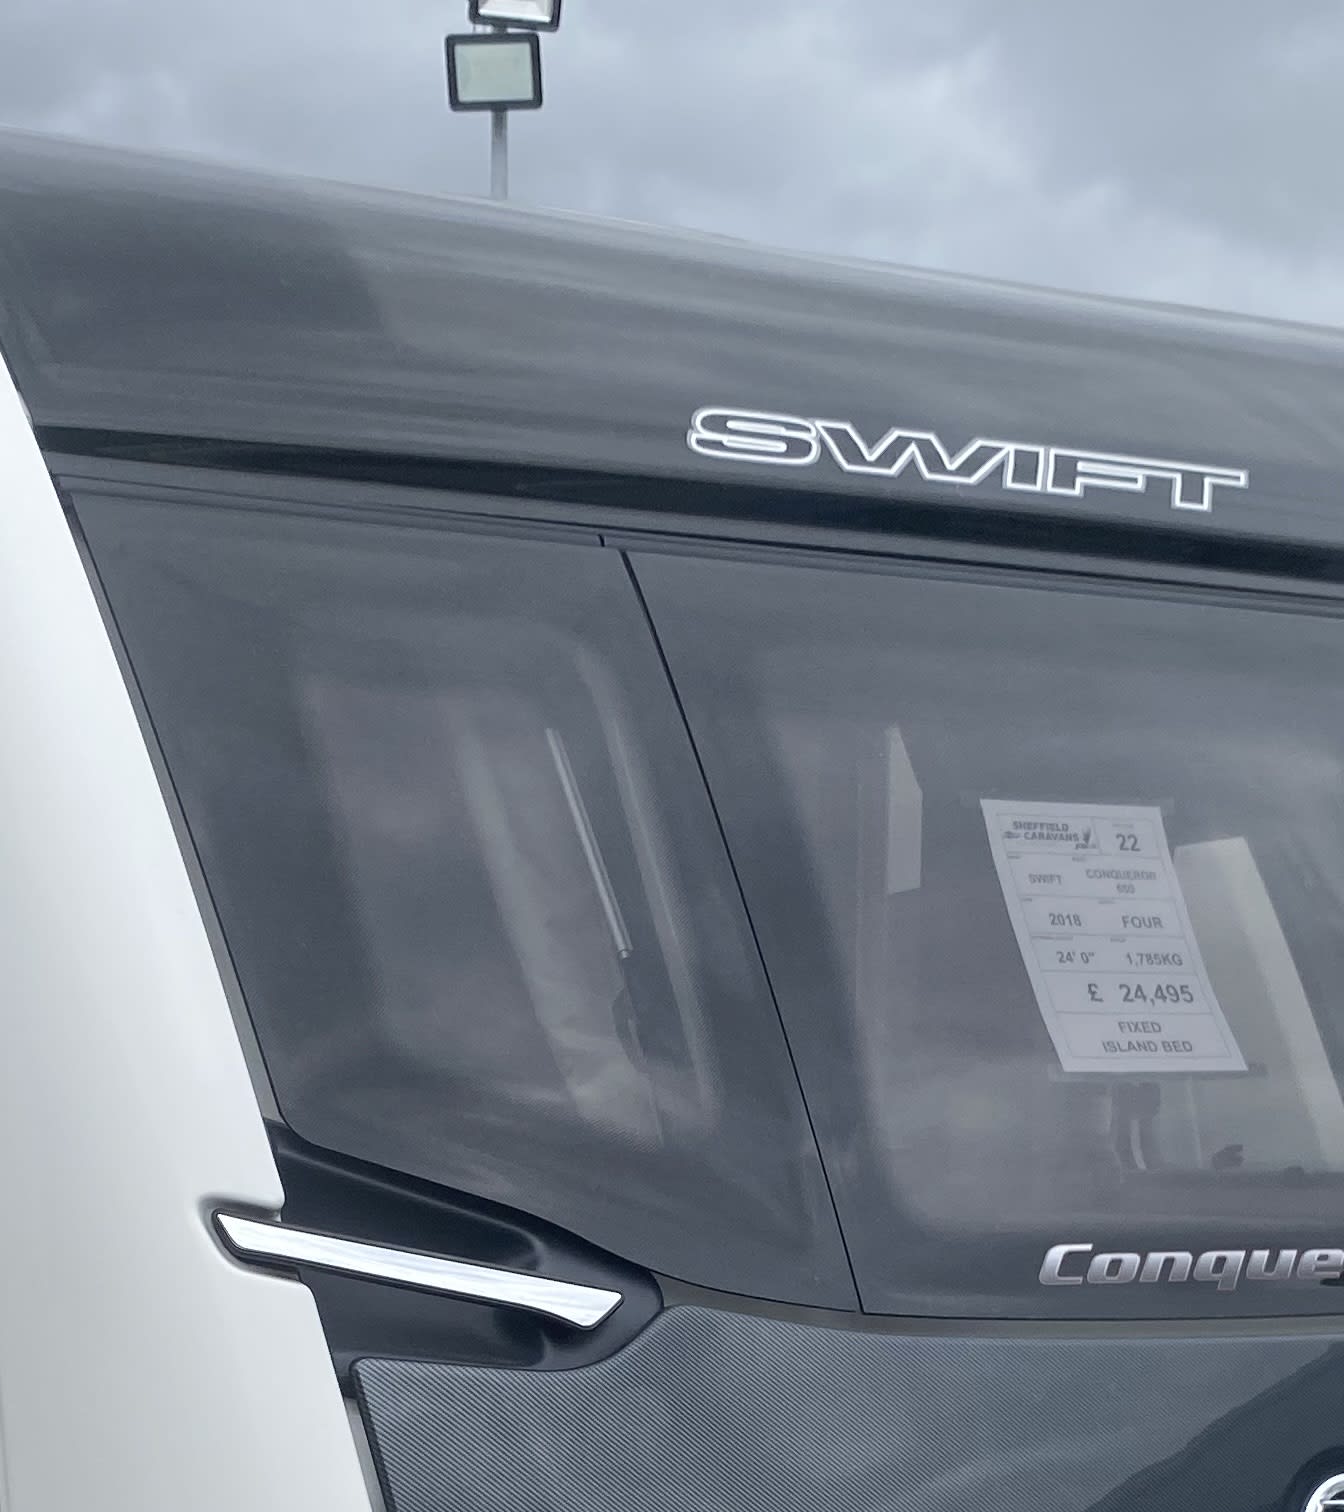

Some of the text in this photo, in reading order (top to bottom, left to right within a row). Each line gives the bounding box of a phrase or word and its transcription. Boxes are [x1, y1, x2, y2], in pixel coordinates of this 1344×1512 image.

[688, 406, 1249, 511] SWIFT
[1023, 831, 1079, 842] CARAVANS
[1115, 833, 1141, 851] 22
[1028, 873, 1062, 885] SWIFT
[1048, 913, 1082, 927] 2018
[1122, 915, 1164, 929] FOUR
[1126, 953, 1184, 967] 1,785KG
[1088, 983, 1194, 1006] £ 24,495
[1118, 1021, 1162, 1034] FIXED
[1102, 1041, 1193, 1053] ISLAND BED
